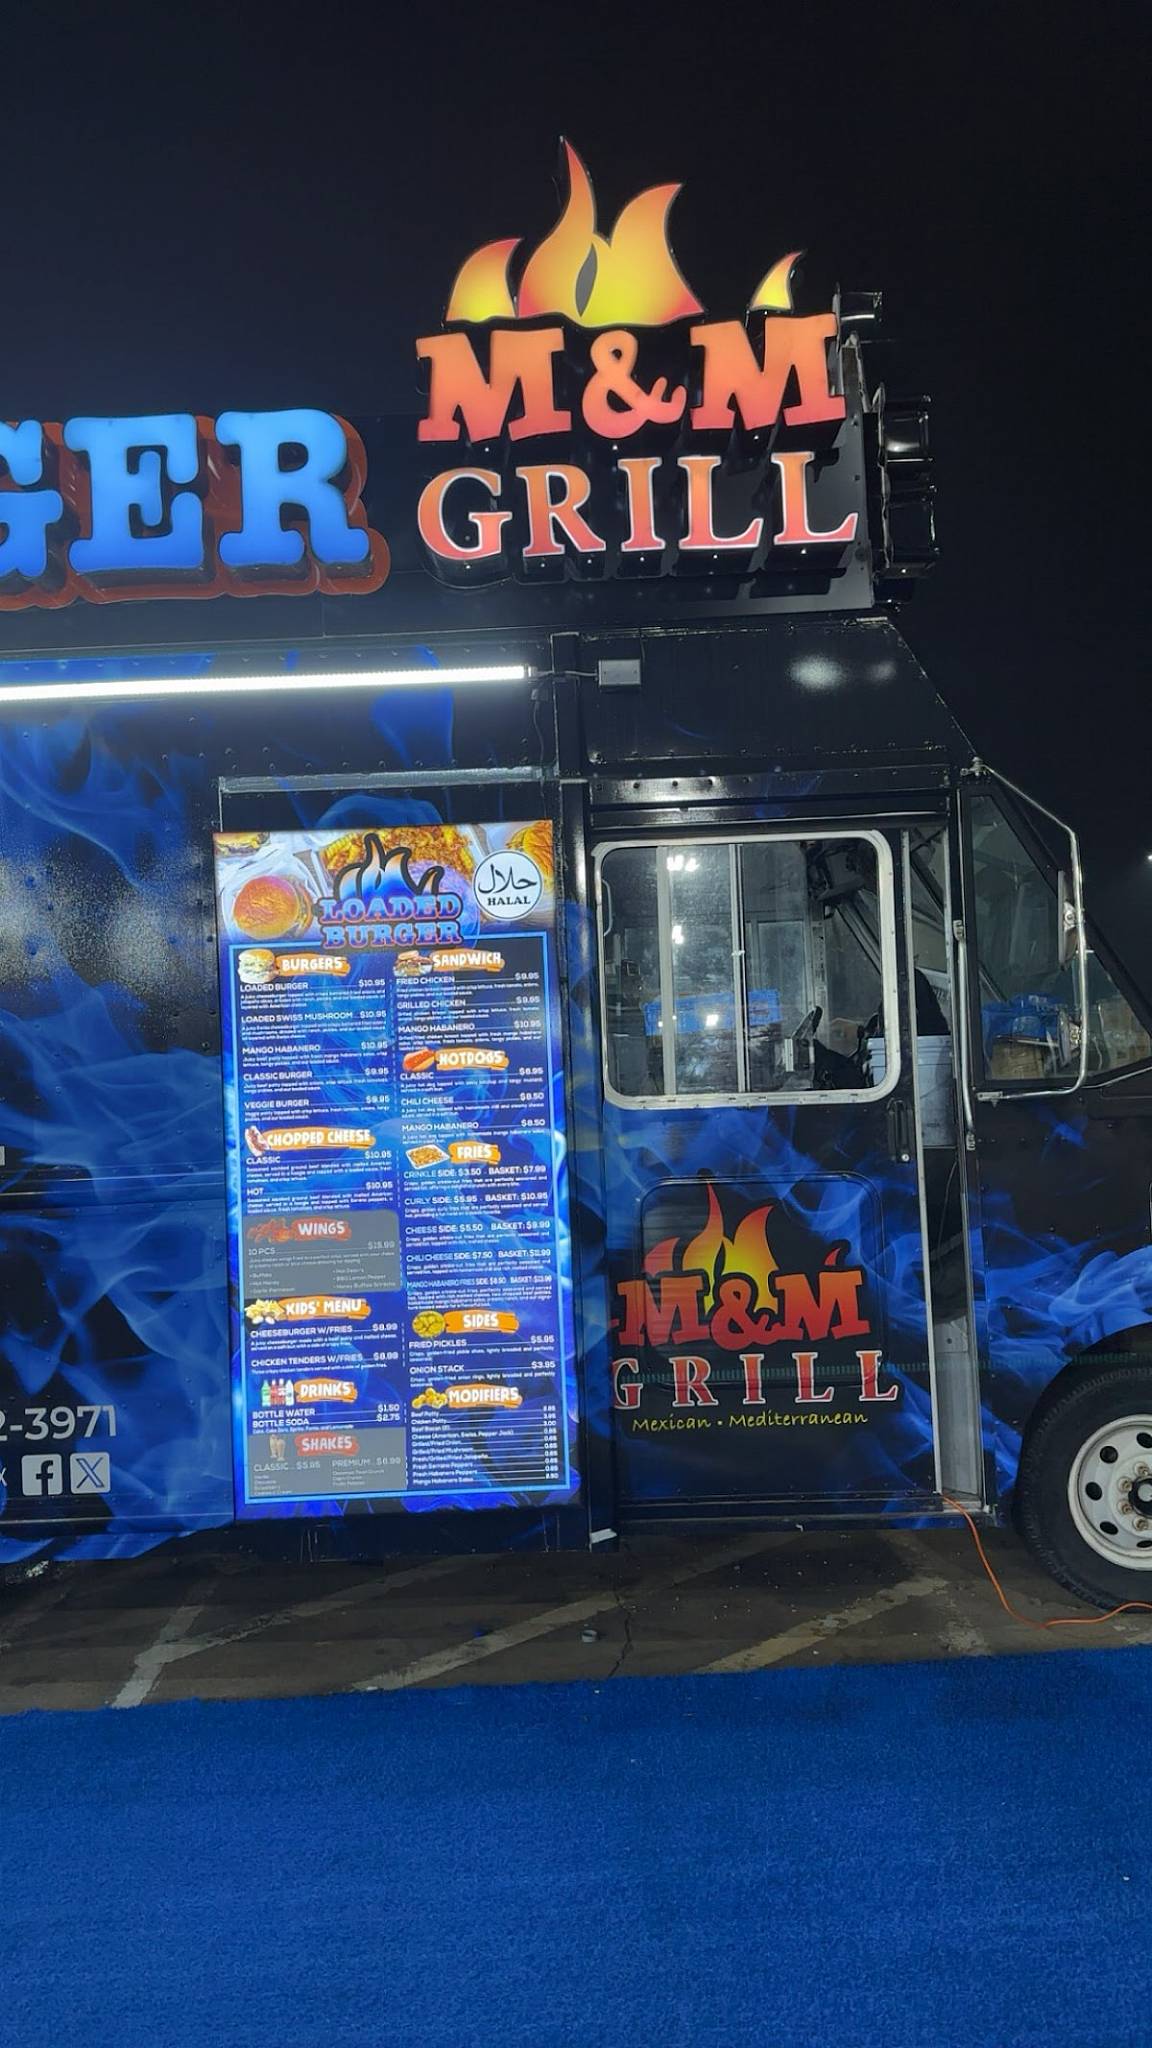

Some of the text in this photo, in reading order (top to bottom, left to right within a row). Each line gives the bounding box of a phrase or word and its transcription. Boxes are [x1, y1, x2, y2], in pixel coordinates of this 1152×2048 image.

[416, 313, 847, 442] M&M
[417, 451, 858, 560] GRILL
[478, 864, 538, 894] حلال
[487, 896, 531, 906] HALAL
[320, 895, 462, 923] LOADED
[323, 921, 462, 948] BURGER
[282, 957, 343, 971] BURGERS
[433, 952, 501, 967] SANDWICH
[396, 977, 418, 985] FRIED
[420, 976, 455, 984] CHICKEN
[240, 983, 274, 992] LOADED
[275, 982, 308, 990] BURGER
[397, 1001, 429, 1009] GRILLED
[431, 999, 466, 1008] CHICKEN
[241, 1014, 275, 1023] LOADED
[276, 1013, 303, 1021] SWISS
[304, 1012, 352, 1020] MUSHROOM
[398, 1025, 428, 1033] MANGO
[430, 1023, 475, 1032] HABANERO
[275, 1044, 320, 1052] HABANERO
[439, 1051, 504, 1065] HOTDOGS
[244, 1073, 278, 1081] CLASSIC
[279, 1071, 312, 1079] BURGER
[400, 1072, 434, 1080] CLASSIC
[244, 1101, 274, 1109] VEGGIE
[276, 1099, 309, 1108] BURGER
[401, 1097, 422, 1106] CHILI
[422, 1096, 454, 1104] CHEESE
[402, 1123, 432, 1132] MANGO
[433, 1122, 479, 1130] HABANERO
[268, 1129, 371, 1146] CHOPPED CHEESE
[457, 1146, 493, 1159] FRIES
[246, 1156, 281, 1165] CLASSIC
[404, 1169, 436, 1178] CRINKLE
[247, 1188, 264, 1196] HOT
[405, 1197, 430, 1205] CURLY
[298, 1221, 345, 1236] WINGS
[405, 1225, 437, 1234] CHEESE
[286, 1299, 362, 1315] KIDS' MENU
[617, 1270, 870, 1350] M&M
[463, 1313, 499, 1328] SIDES
[250, 1327, 316, 1338] CHEESEBURGER
[317, 1325, 352, 1334] W/FRIES
[409, 1341, 432, 1349] FRIED
[434, 1339, 467, 1348] PICKLES
[251, 1358, 287, 1367] CHICKEN
[289, 1356, 326, 1365] TENDERS
[327, 1354, 363, 1363] W/FRIES
[410, 1366, 437, 1375] ONION
[438, 1365, 464, 1373] STACK
[612, 1350, 898, 1410] GRILL
[300, 1382, 350, 1397] DRINKS
[448, 1387, 519, 1403] MODIFIERS
[253, 1410, 284, 1419] BOTTLE
[286, 1408, 315, 1417] WATER
[253, 1414, 400, 1428] BOTTLE SODA $2.75
[632, 1410, 868, 1431] Mexican Mediterranean
[302, 1436, 352, 1450] SHAKES
[254, 1462, 289, 1472] CLASSIC
[332, 1459, 370, 1467] PREMIUM
